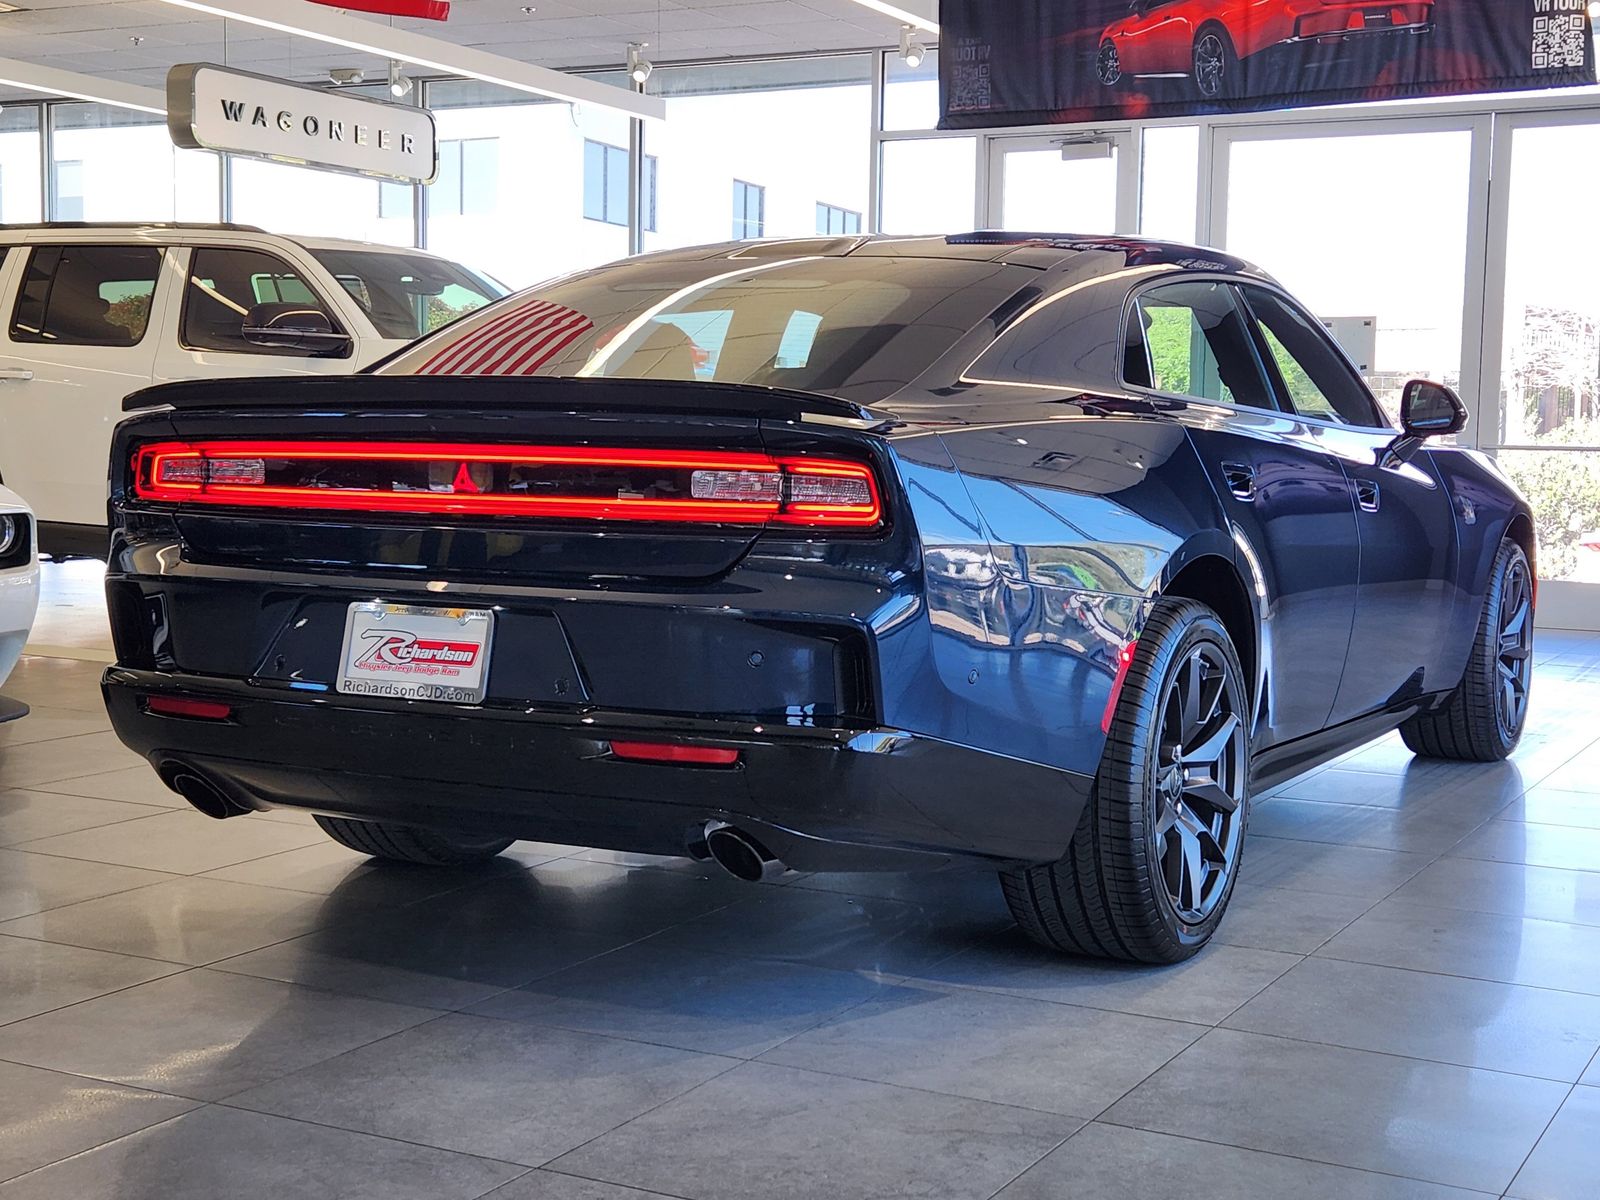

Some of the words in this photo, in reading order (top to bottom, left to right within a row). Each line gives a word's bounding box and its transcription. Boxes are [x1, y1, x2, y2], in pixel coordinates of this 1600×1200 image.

[1534, 0, 1550, 12] VR
[221, 99, 416, 154] WAGONEER
[354, 629, 474, 667] Richardson
[414, 665, 440, 676] Dodge
[343, 681, 475, 702] RichardsonCJD.com
